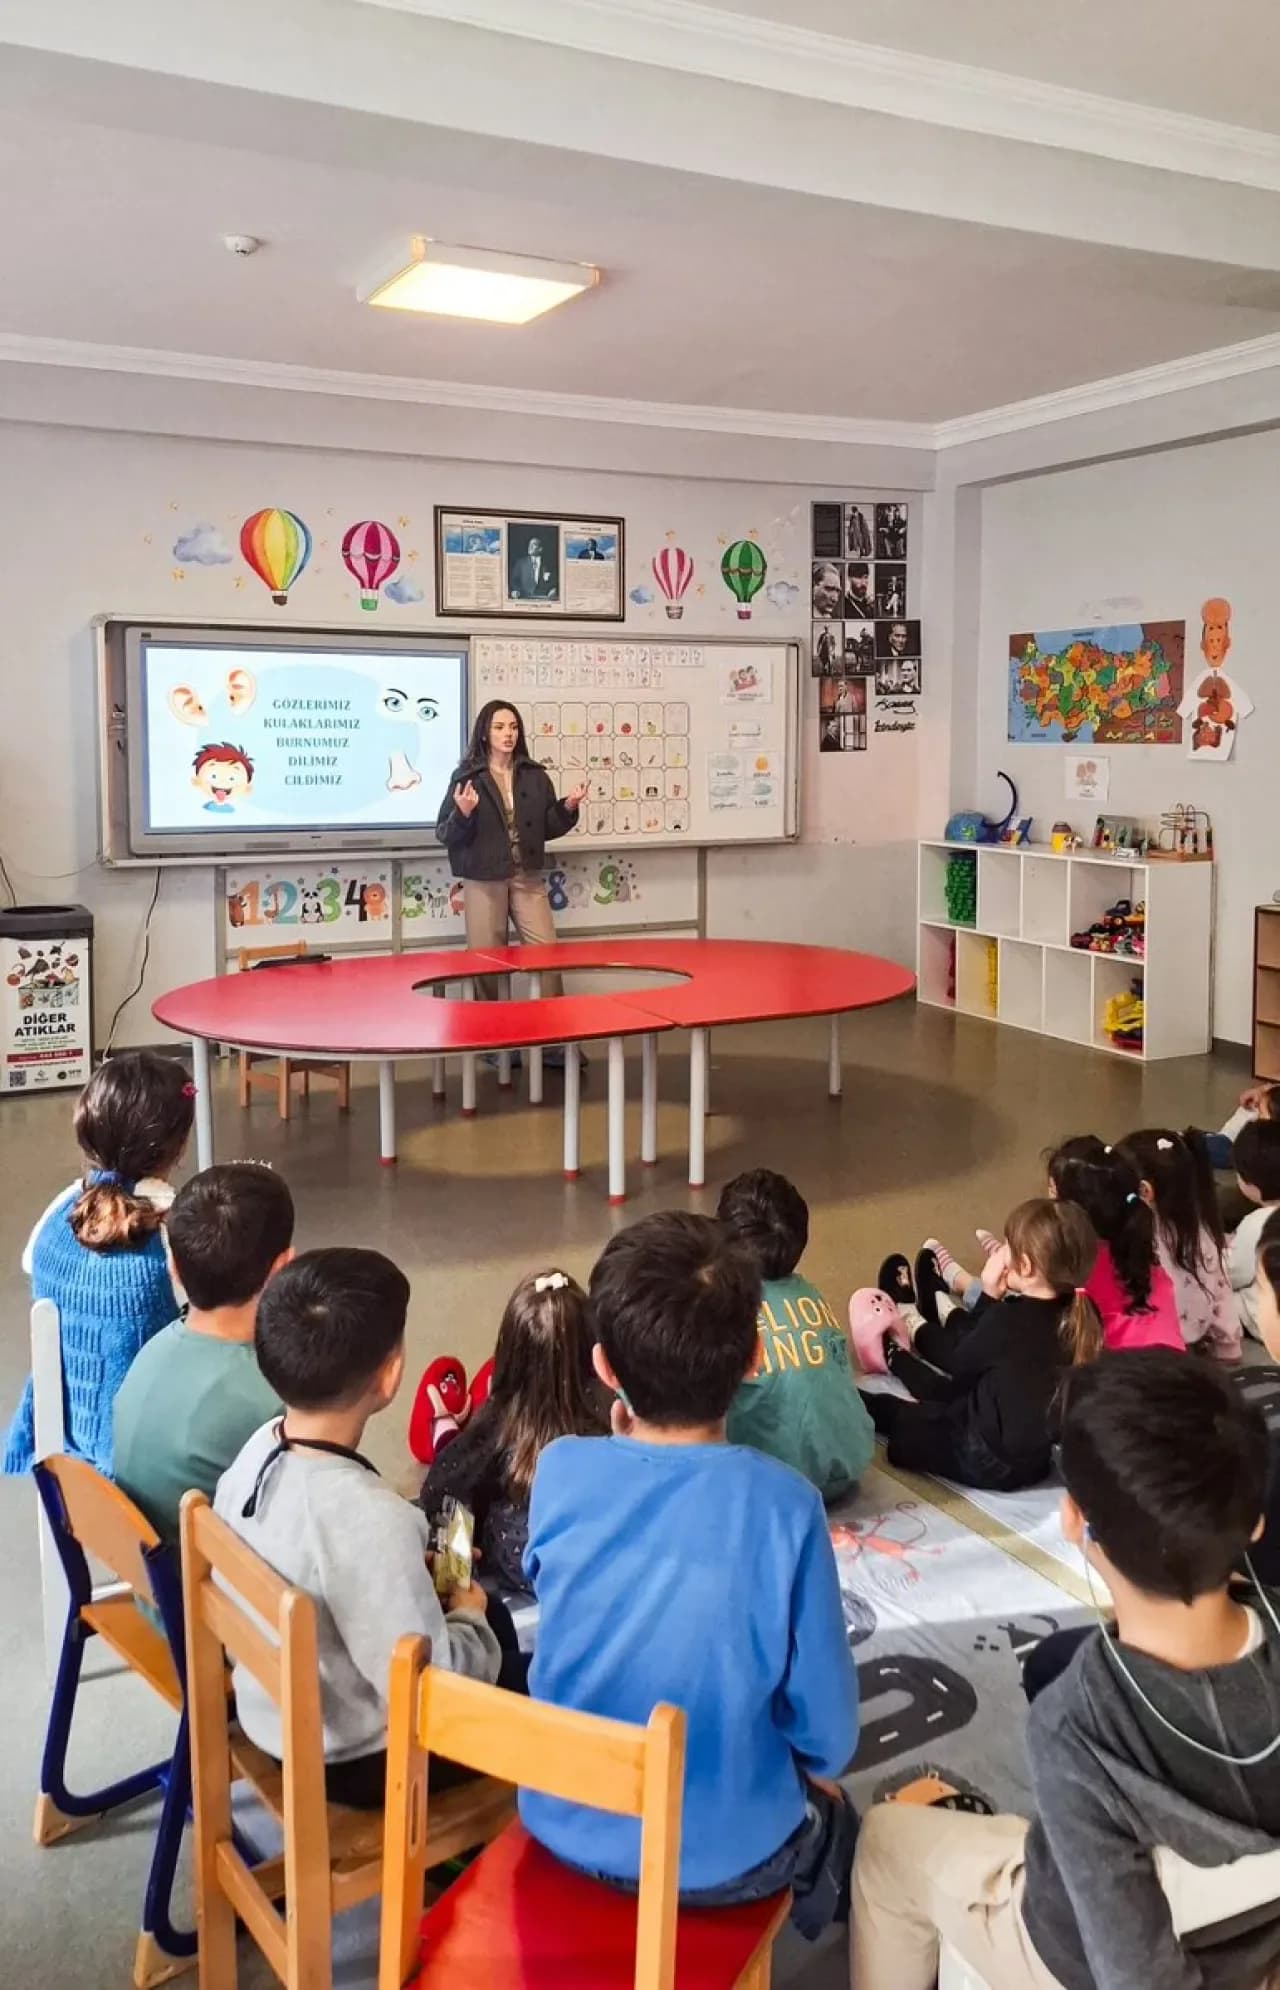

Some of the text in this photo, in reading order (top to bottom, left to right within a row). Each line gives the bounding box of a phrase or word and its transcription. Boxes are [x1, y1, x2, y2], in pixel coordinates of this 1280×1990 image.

[263, 717, 361, 729] KULAKLARIMIZ
[276, 736, 350, 748] BURNUMUZ
[317, 877, 341, 923] 3
[23, 1012, 67, 1025] DİĞER
[14, 1023, 76, 1037] ATIKLAR
[761, 1297, 840, 1331] LION
[756, 1330, 824, 1376] ING
